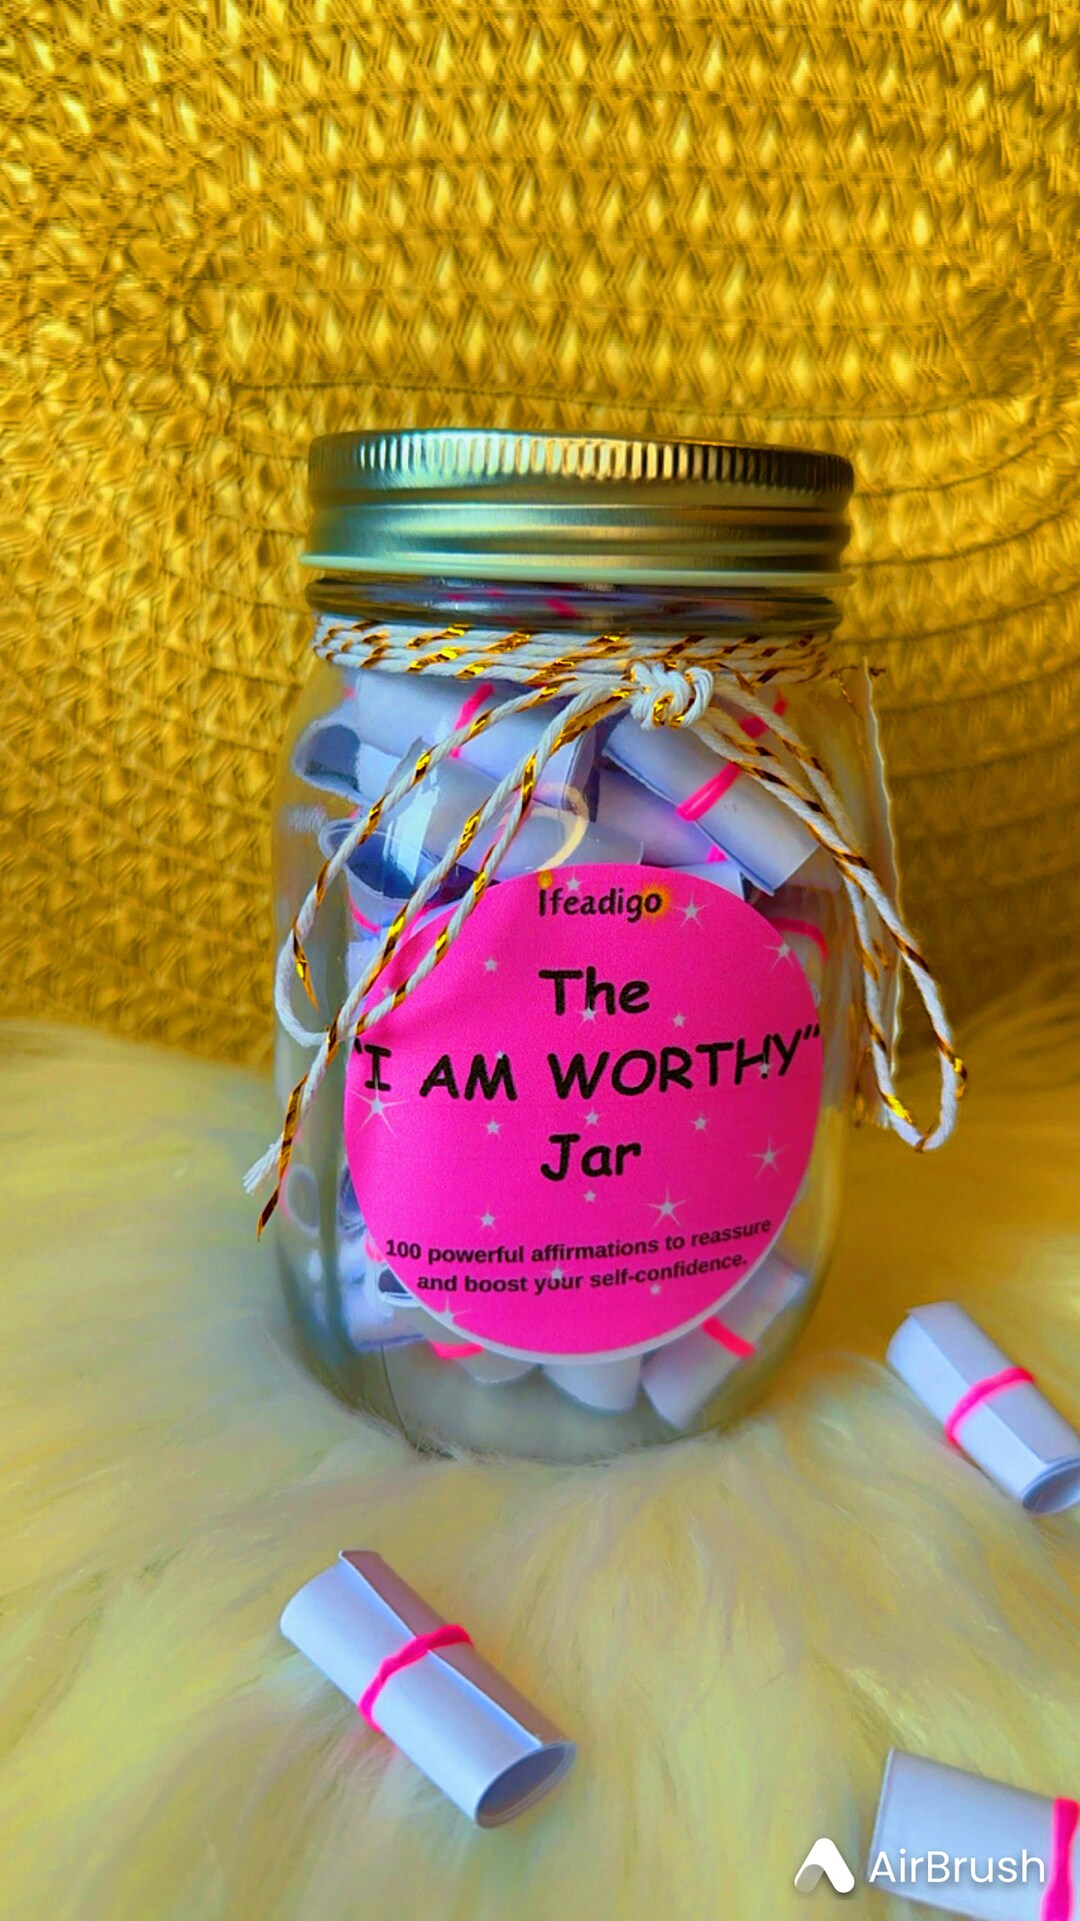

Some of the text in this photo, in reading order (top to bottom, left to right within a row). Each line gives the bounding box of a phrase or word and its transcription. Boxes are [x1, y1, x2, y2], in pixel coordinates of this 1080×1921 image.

[538, 966, 651, 1015] The
[420, 1053, 518, 1101] AM
[540, 1133, 642, 1182] Jar
[386, 1218, 772, 1265] 100 powerful affirmations to reassure
[417, 1251, 748, 1296] and boost your self-confidence.
